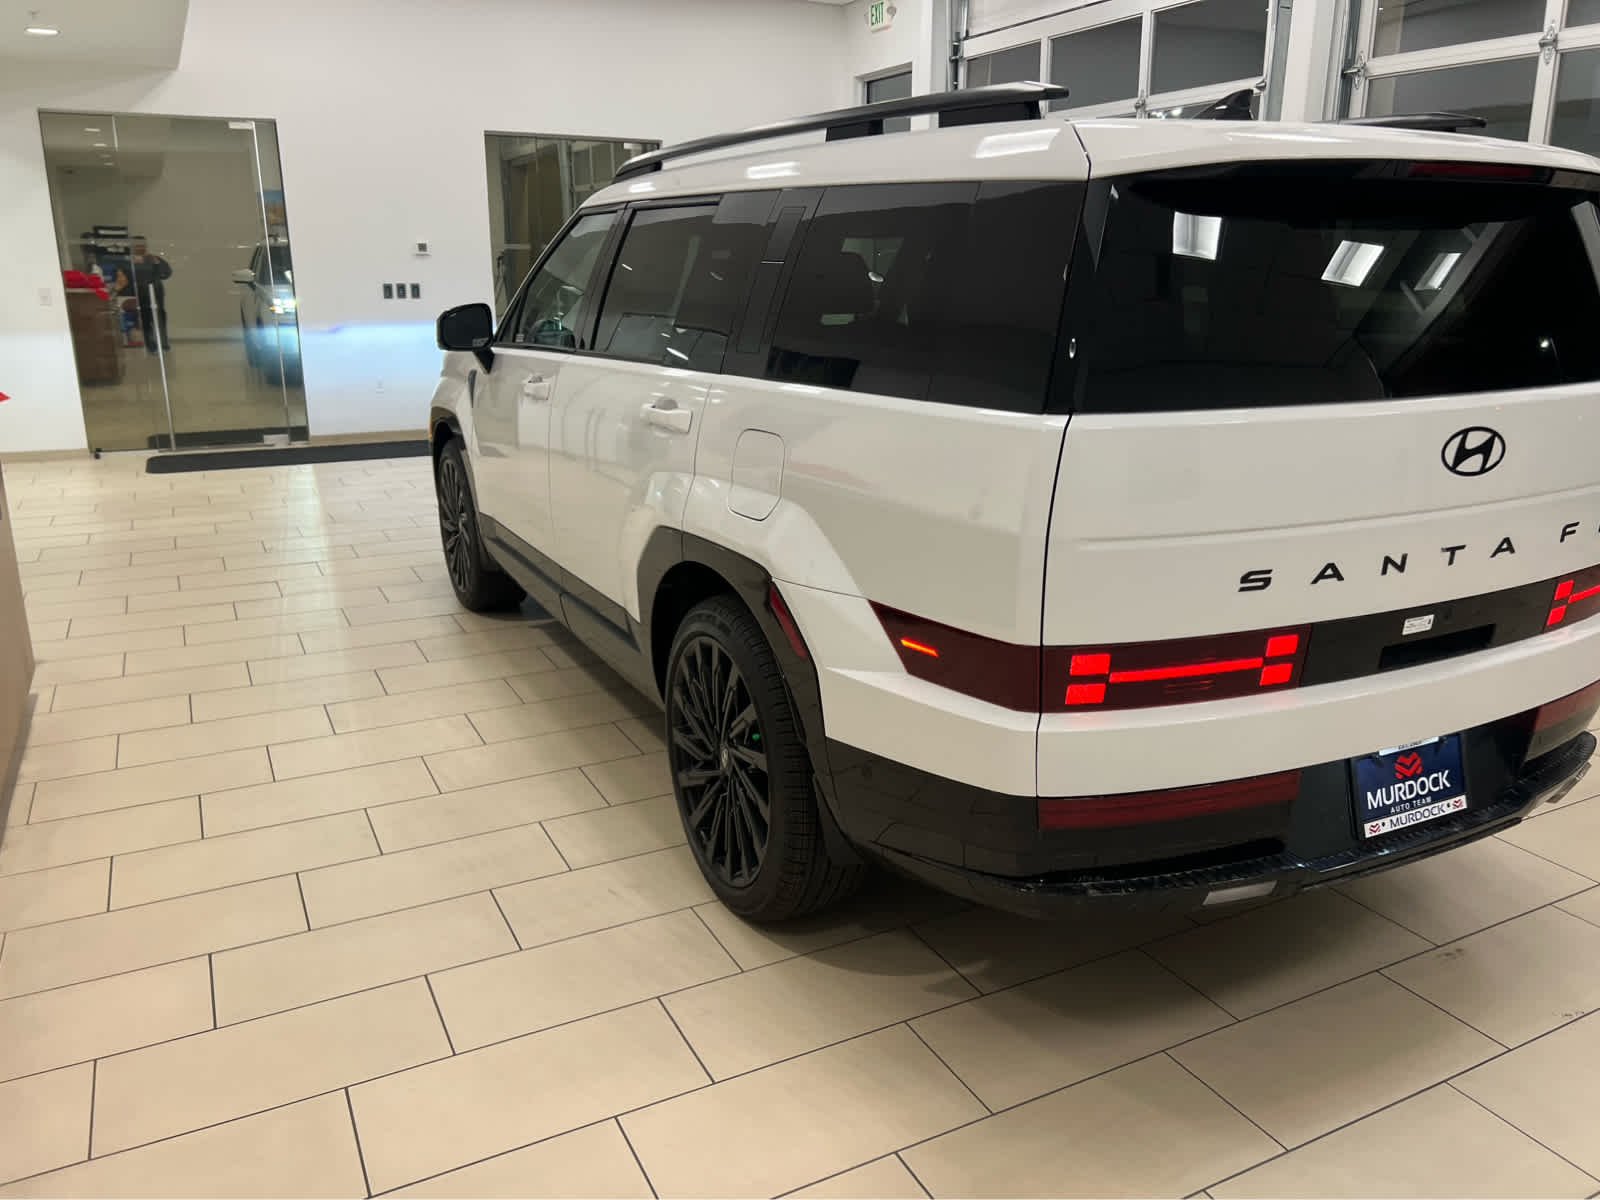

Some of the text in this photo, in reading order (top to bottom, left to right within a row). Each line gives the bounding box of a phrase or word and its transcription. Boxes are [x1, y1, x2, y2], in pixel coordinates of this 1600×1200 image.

[871, 2, 884, 25] EXIT
[1238, 521, 1600, 592] SANTA F
[1366, 770, 1451, 810] MURDOCK
[1389, 804, 1446, 829] MURDOCK
[1390, 796, 1432, 814] AUTO TEAM
